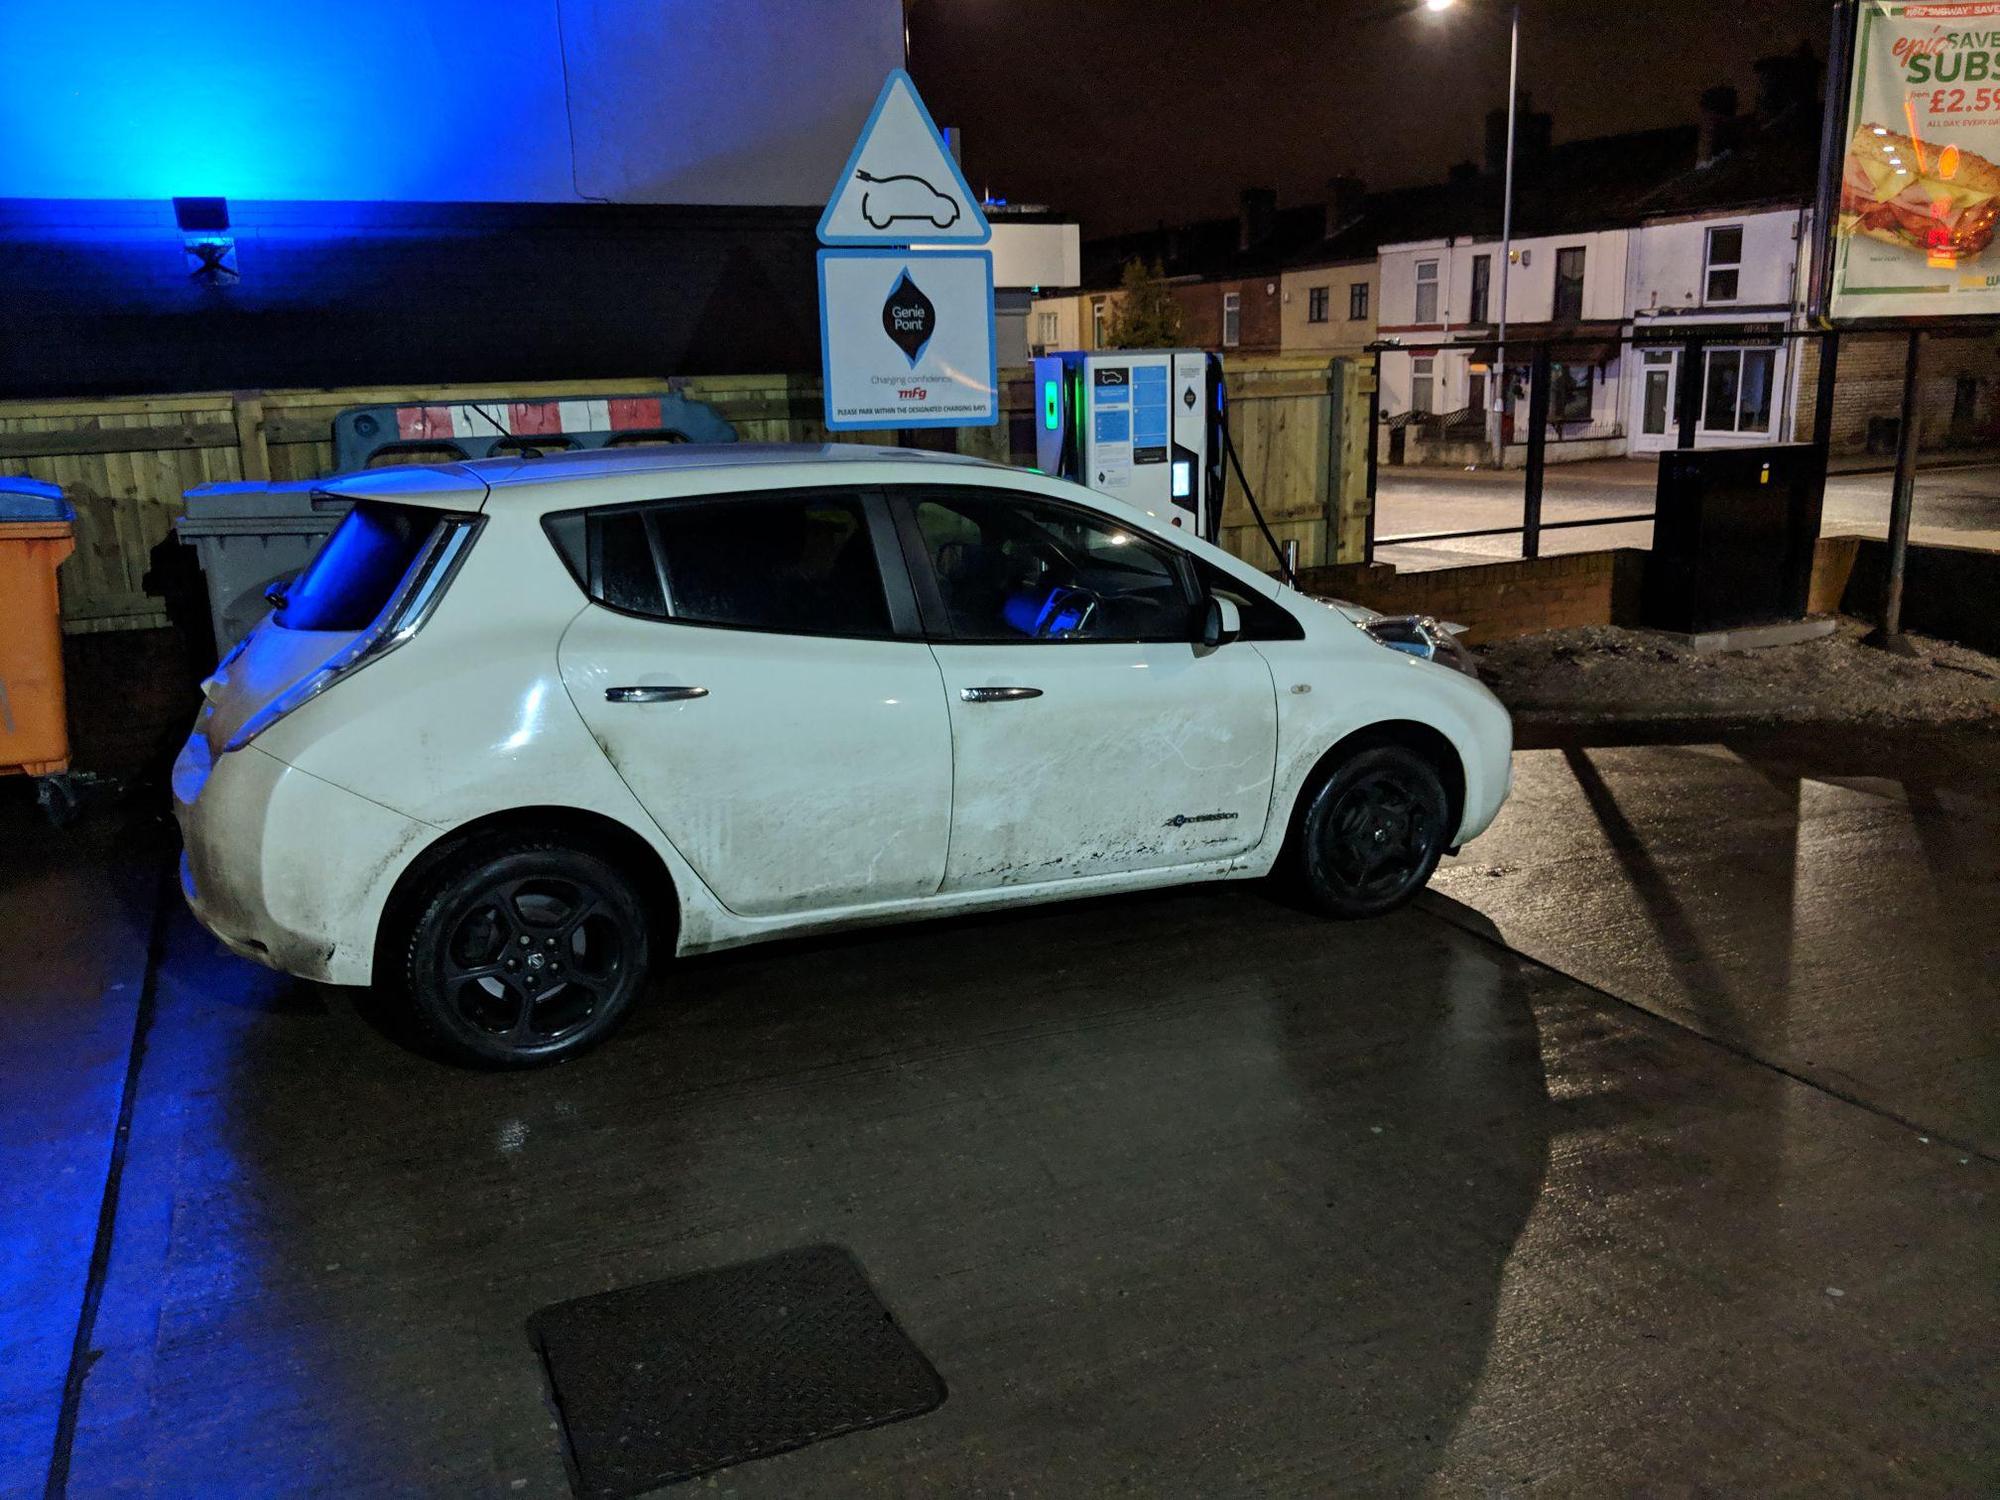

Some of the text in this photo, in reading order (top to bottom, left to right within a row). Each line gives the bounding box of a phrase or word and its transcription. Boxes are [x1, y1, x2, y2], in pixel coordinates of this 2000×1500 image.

[1892, 25, 1950, 68] epic
[892, 304, 926, 318] Genie
[894, 319, 924, 330] Point
[871, 374, 953, 386] Charging confidence
[898, 386, 928, 400] mfg
[837, 408, 857, 416] PLEASE
[874, 407, 896, 415] WITHIN
[897, 406, 907, 414] THE
[908, 405, 943, 414] DESIGNATED
[943, 404, 972, 413] CHARGING
[973, 404, 986, 412] BAYS
